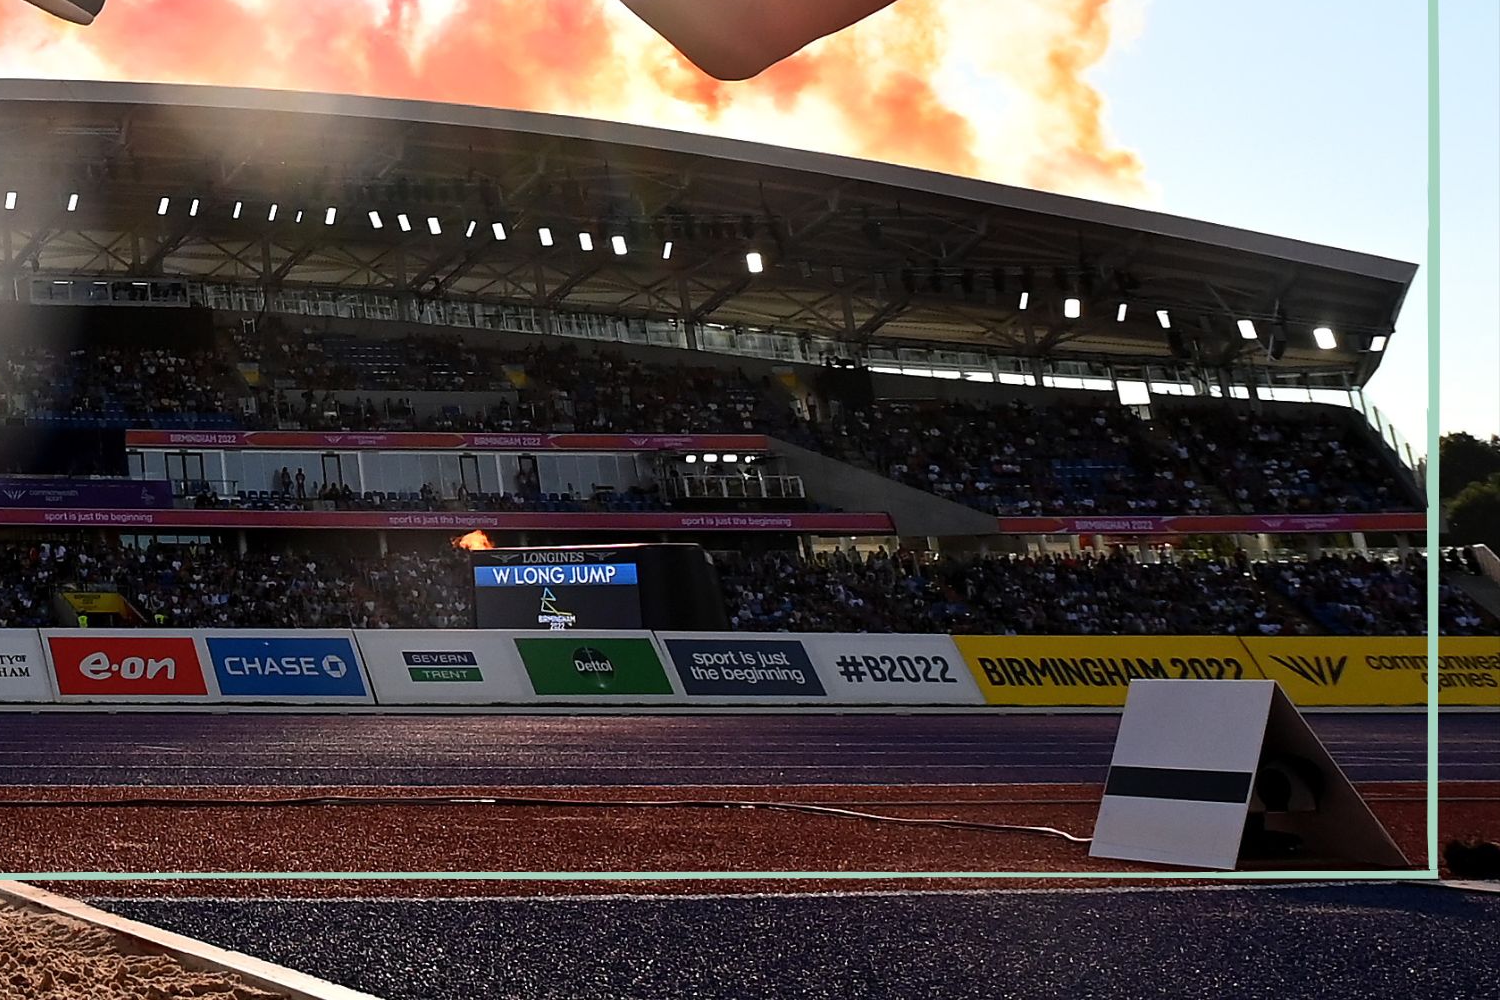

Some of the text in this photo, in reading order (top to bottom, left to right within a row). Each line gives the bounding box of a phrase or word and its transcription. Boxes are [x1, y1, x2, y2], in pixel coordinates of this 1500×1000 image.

[218, 435, 236, 444] 2022
[44, 512, 67, 521] sport
[77, 512, 94, 521] just
[110, 513, 153, 523] beginning
[389, 515, 412, 525] sport
[422, 515, 438, 525] just
[455, 516, 498, 526] beginning
[681, 517, 704, 526] sport
[714, 517, 732, 526] just
[747, 517, 791, 527] beginning
[523, 552, 585, 563] LONGINES
[492, 566, 616, 584] W LONG JUMP
[411, 655, 468, 664] SEVERN
[692, 651, 790, 668] sport is just
[1365, 652, 1500, 670] commonwea
[224, 656, 320, 676] CHASE
[574, 660, 613, 672] Dettol
[836, 655, 957, 683] #B2022
[977, 657, 1169, 686] BIRMINGHAM
[423, 670, 469, 679] TRENT
[689, 665, 806, 684] the beginning
